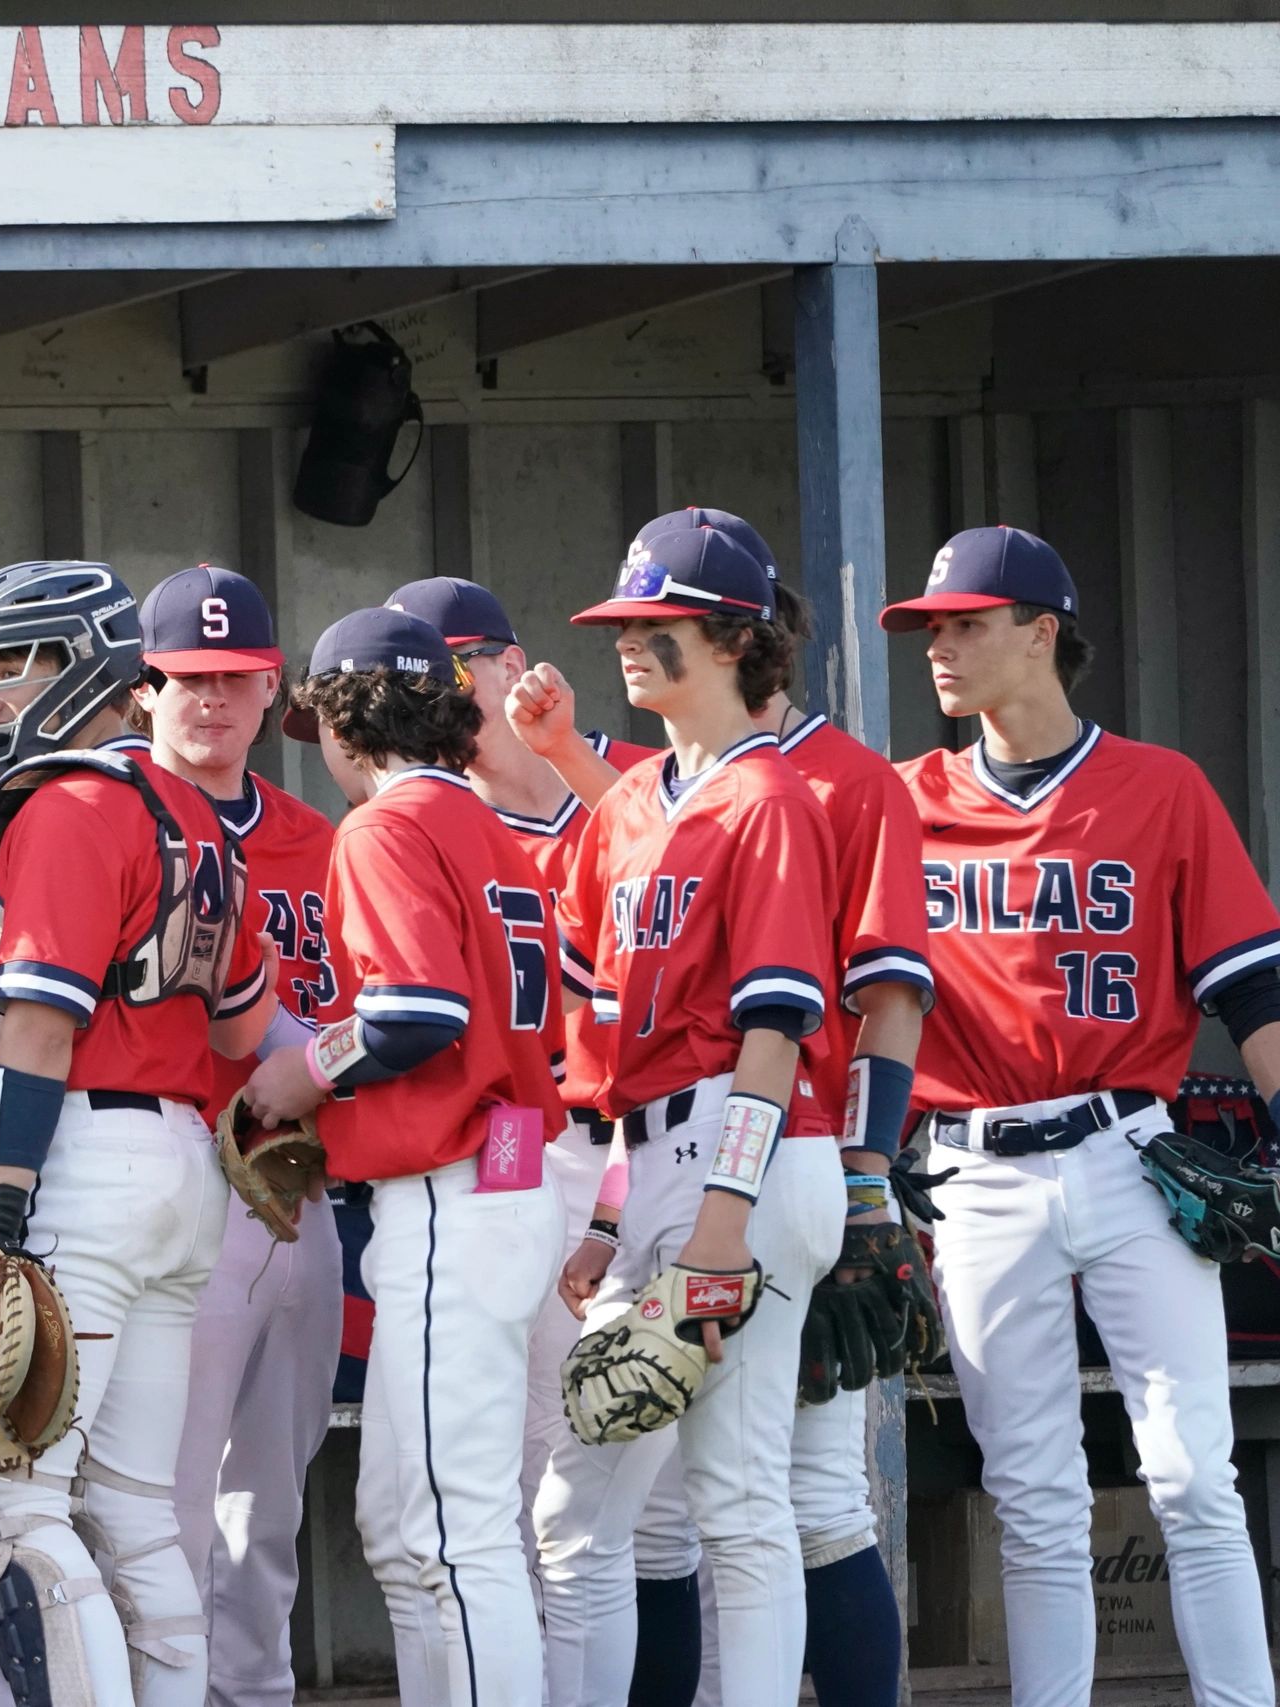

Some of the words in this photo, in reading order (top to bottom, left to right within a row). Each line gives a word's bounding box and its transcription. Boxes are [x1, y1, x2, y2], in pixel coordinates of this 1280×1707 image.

[928, 547, 954, 586] S
[200, 598, 230, 638] S
[396, 655, 430, 674] RAMS
[921, 858, 1136, 935] SILAS
[1055, 950, 1139, 1024] 16
[1092, 1535, 1170, 1584] den
[1107, 1620, 1156, 1634] CHINA
